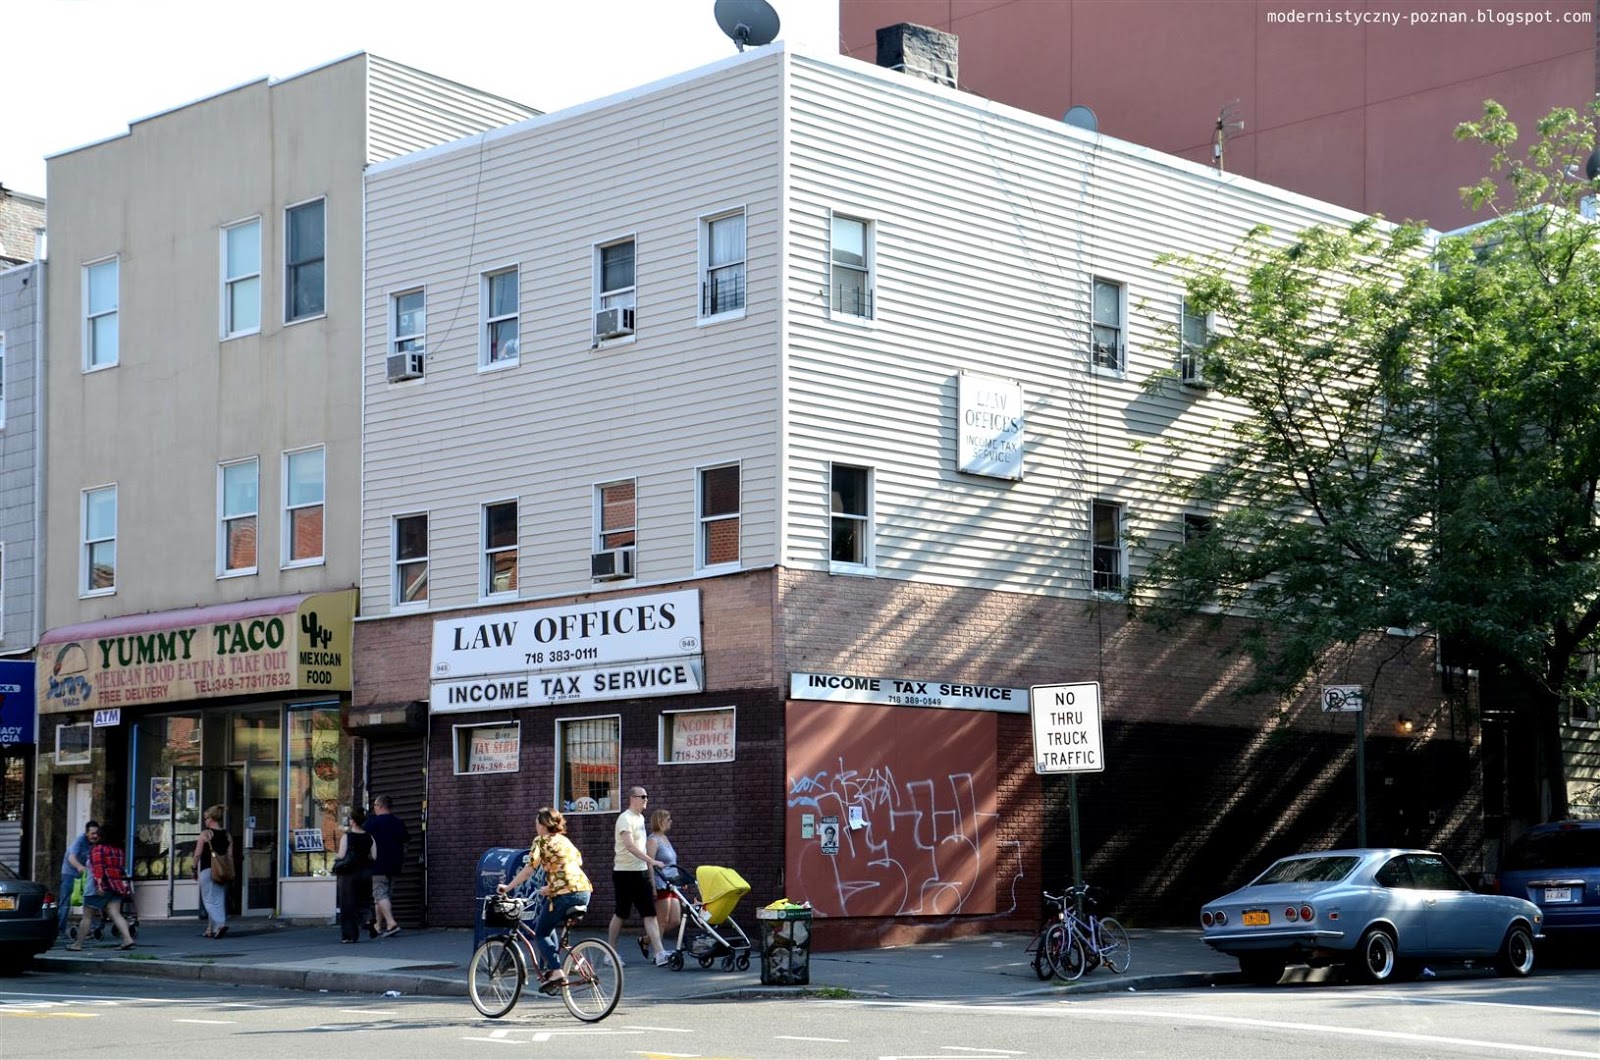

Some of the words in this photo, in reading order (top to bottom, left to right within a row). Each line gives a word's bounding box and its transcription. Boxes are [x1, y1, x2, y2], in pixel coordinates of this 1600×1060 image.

[965, 409, 1019, 434] OFFICES
[1001, 440, 1018, 453] TAX
[452, 621, 519, 652] LAW
[534, 602, 676, 644] OFFICES
[98, 628, 197, 669] YUMMY
[213, 617, 285, 655] TACO
[682, 639, 696, 648] 945
[300, 651, 342, 667] MEXICAN
[525, 652, 544, 665] 718
[549, 647, 598, 663] 383-0111
[95, 668, 141, 689] MEXICAN
[144, 664, 174, 684] FOOD
[178, 661, 199, 681] EAT
[202, 659, 214, 678] IN
[217, 658, 226, 676] &
[230, 655, 260, 675] TAKE
[263, 651, 288, 670] OUT
[307, 670, 332, 685] FOOD
[448, 681, 528, 704] INCOME
[541, 675, 581, 696] TAX
[594, 666, 687, 692] SERVICE
[808, 675, 881, 692] INCOME
[893, 681, 928, 695] TAX
[939, 684, 1012, 701] SERVICE
[98, 690, 122, 704] FREE
[125, 685, 169, 701] DELIVERY
[888, 695, 901, 704] 718
[905, 696, 942, 706] 389-0549
[1055, 692, 1075, 706] NO
[96, 709, 119, 724] ATM
[1050, 711, 1083, 726] THRU
[676, 718, 718, 732] INCOME
[686, 732, 730, 747] SERVICE
[1047, 731, 1088, 746] TRUCK
[475, 742, 490, 755] TAX
[1043, 750, 1095, 766] TRAFFIC
[577, 801, 595, 812] 945
[297, 835, 323, 848] ATM
